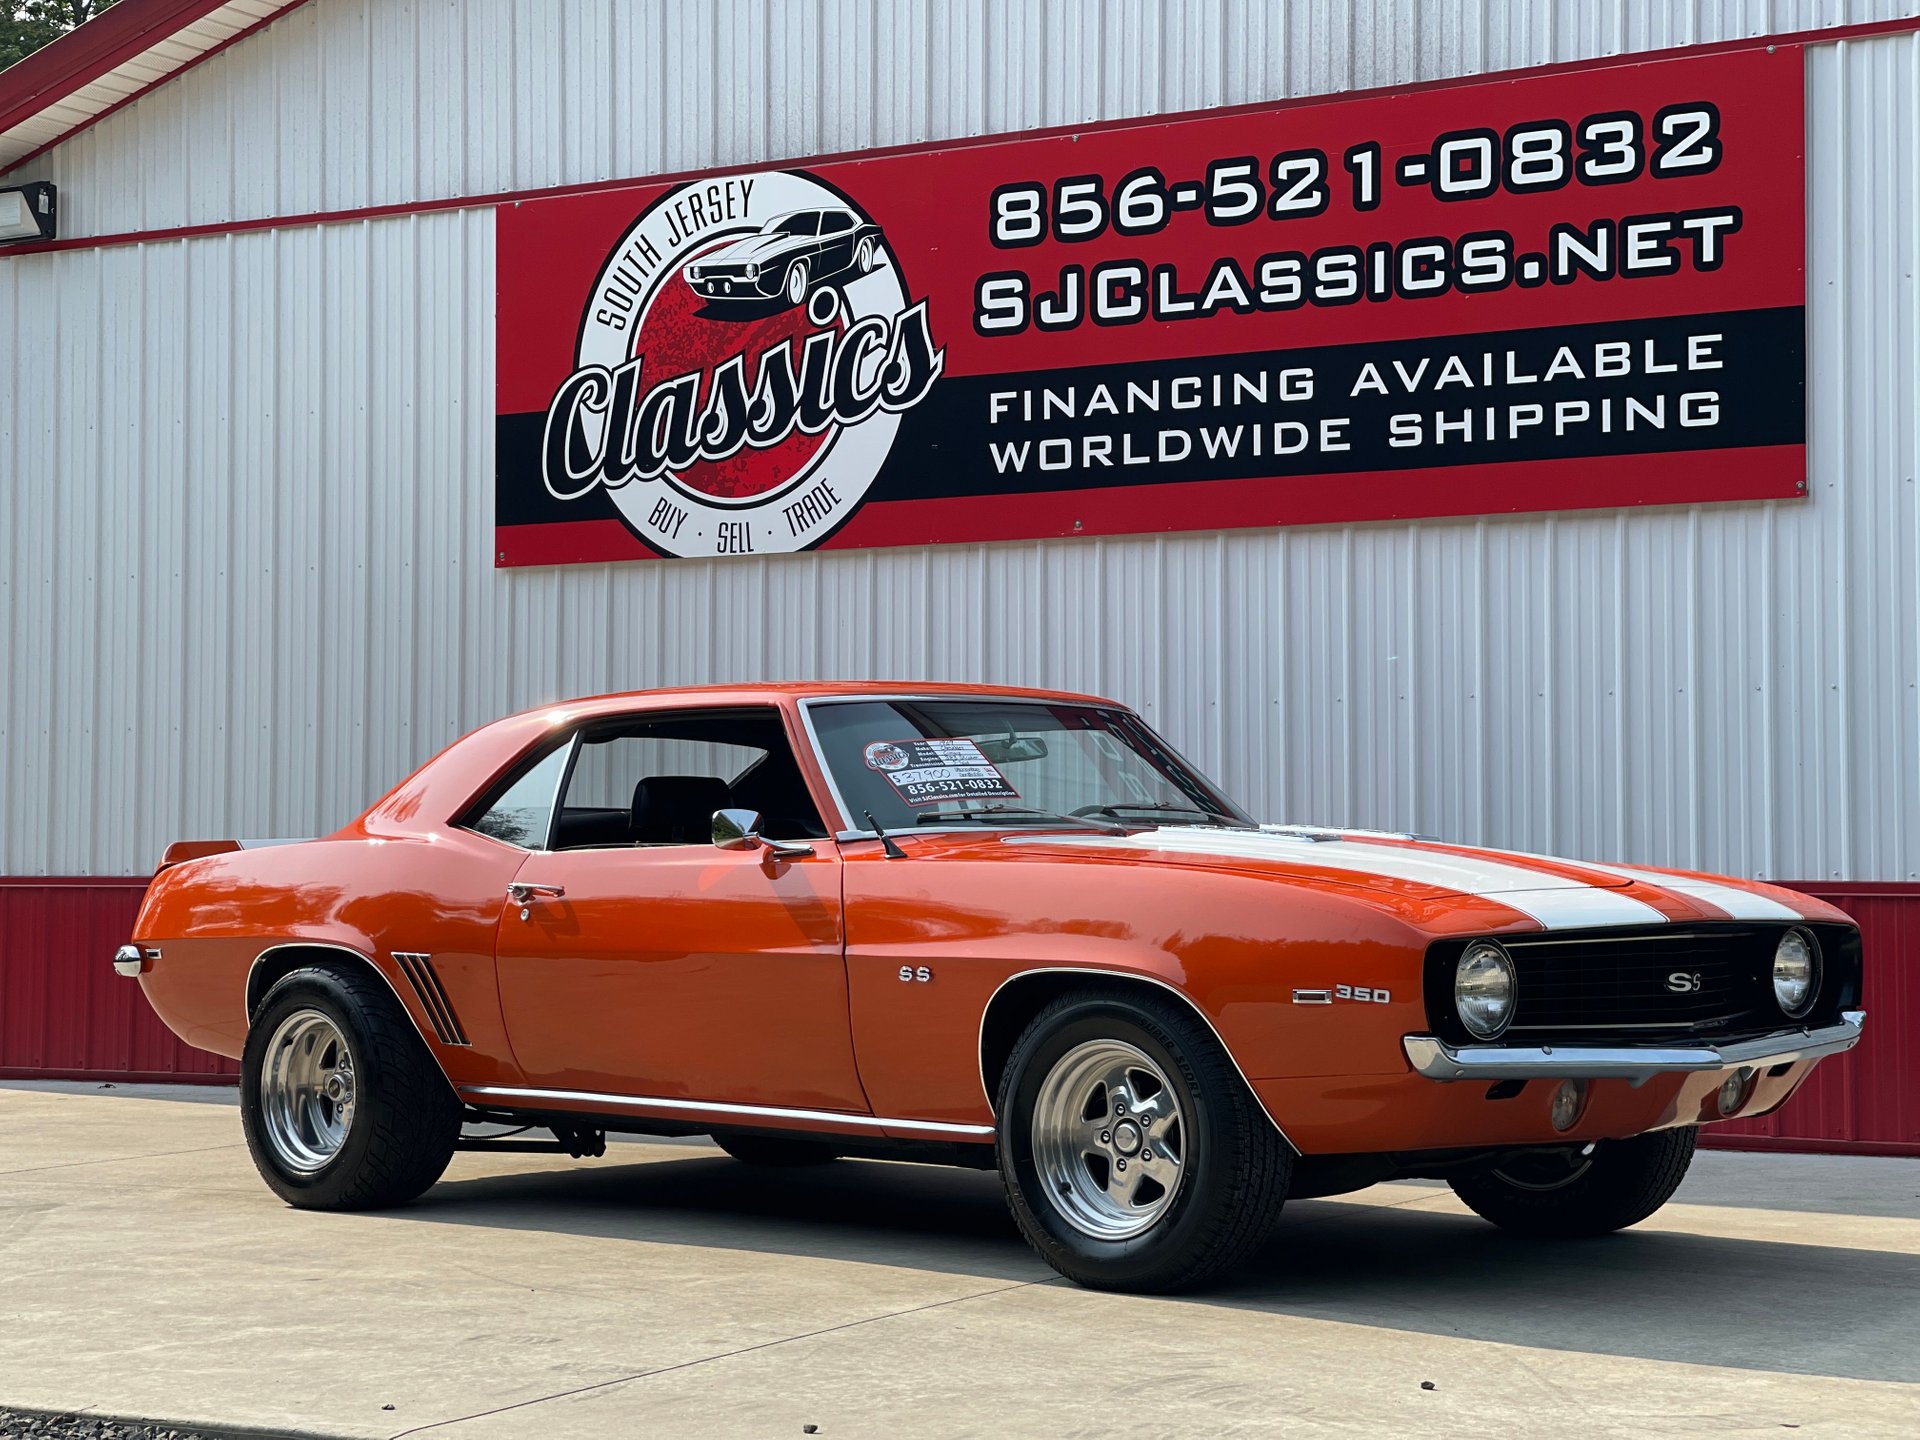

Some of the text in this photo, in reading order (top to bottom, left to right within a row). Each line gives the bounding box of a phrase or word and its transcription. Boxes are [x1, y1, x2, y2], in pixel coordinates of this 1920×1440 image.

[994, 107, 1716, 243] 856-521-0832
[596, 179, 754, 331] SOUTH JERSEY
[977, 213, 1736, 331] SJCLASSICS.NET
[542, 284, 946, 500] Classics
[989, 333, 1724, 424] FINANCING AVAILABLE
[988, 390, 1720, 474] WORLDWIDE SHIPPING
[648, 478, 842, 553] BUY SELL TRADE
[908, 779, 1003, 795] 856-521-0832
[898, 965, 930, 982] SS
[1335, 983, 1390, 1004] 350
[1667, 972, 1701, 992] SS
[1137, 1018, 1202, 1099] SUPER SPORT
